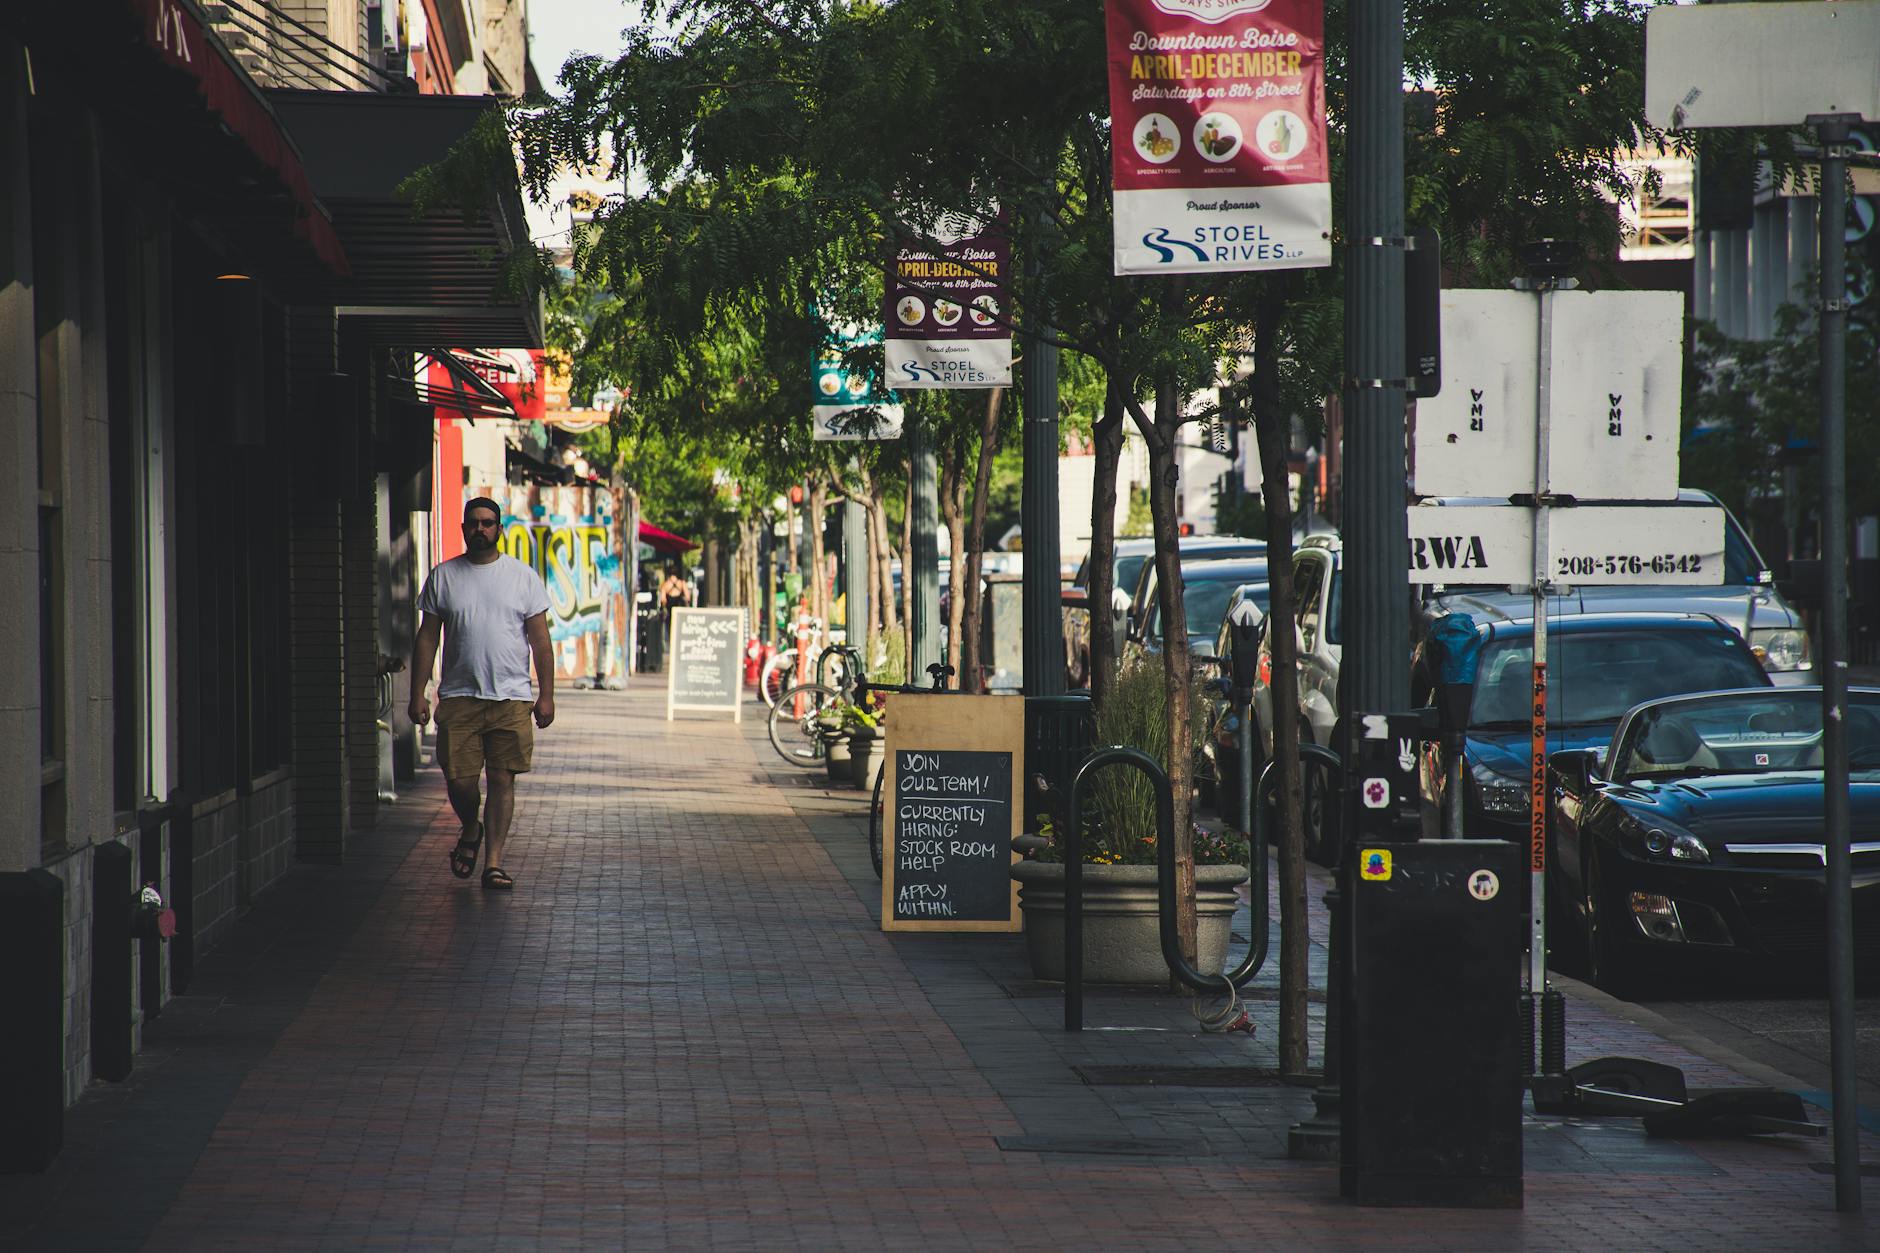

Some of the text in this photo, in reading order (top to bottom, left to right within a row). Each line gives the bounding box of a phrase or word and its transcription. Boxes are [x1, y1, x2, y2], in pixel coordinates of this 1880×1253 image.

[1129, 28, 1299, 50] Downtown Boise
[1131, 51, 1302, 80] APRIL-DECEMBER
[1132, 81, 1303, 103] Saturdays on 8th Street
[1187, 199, 1261, 211] Proud Sponsor
[1195, 225, 1270, 243] STOEL
[962, 247, 996, 260] Boise
[1216, 244, 1284, 261] RIVES
[926, 345, 970, 354] Proud Sponsor
[931, 361, 975, 371] STOEL
[944, 372, 984, 382] RIVES
[1558, 554, 1702, 575] 208-576-6542
[902, 753, 940, 773] JOIN
[900, 776, 938, 792] OUR
[902, 821, 958, 838] HIRING:
[900, 839, 995, 858] STOCK ROOM
[899, 883, 947, 900] APPLY
